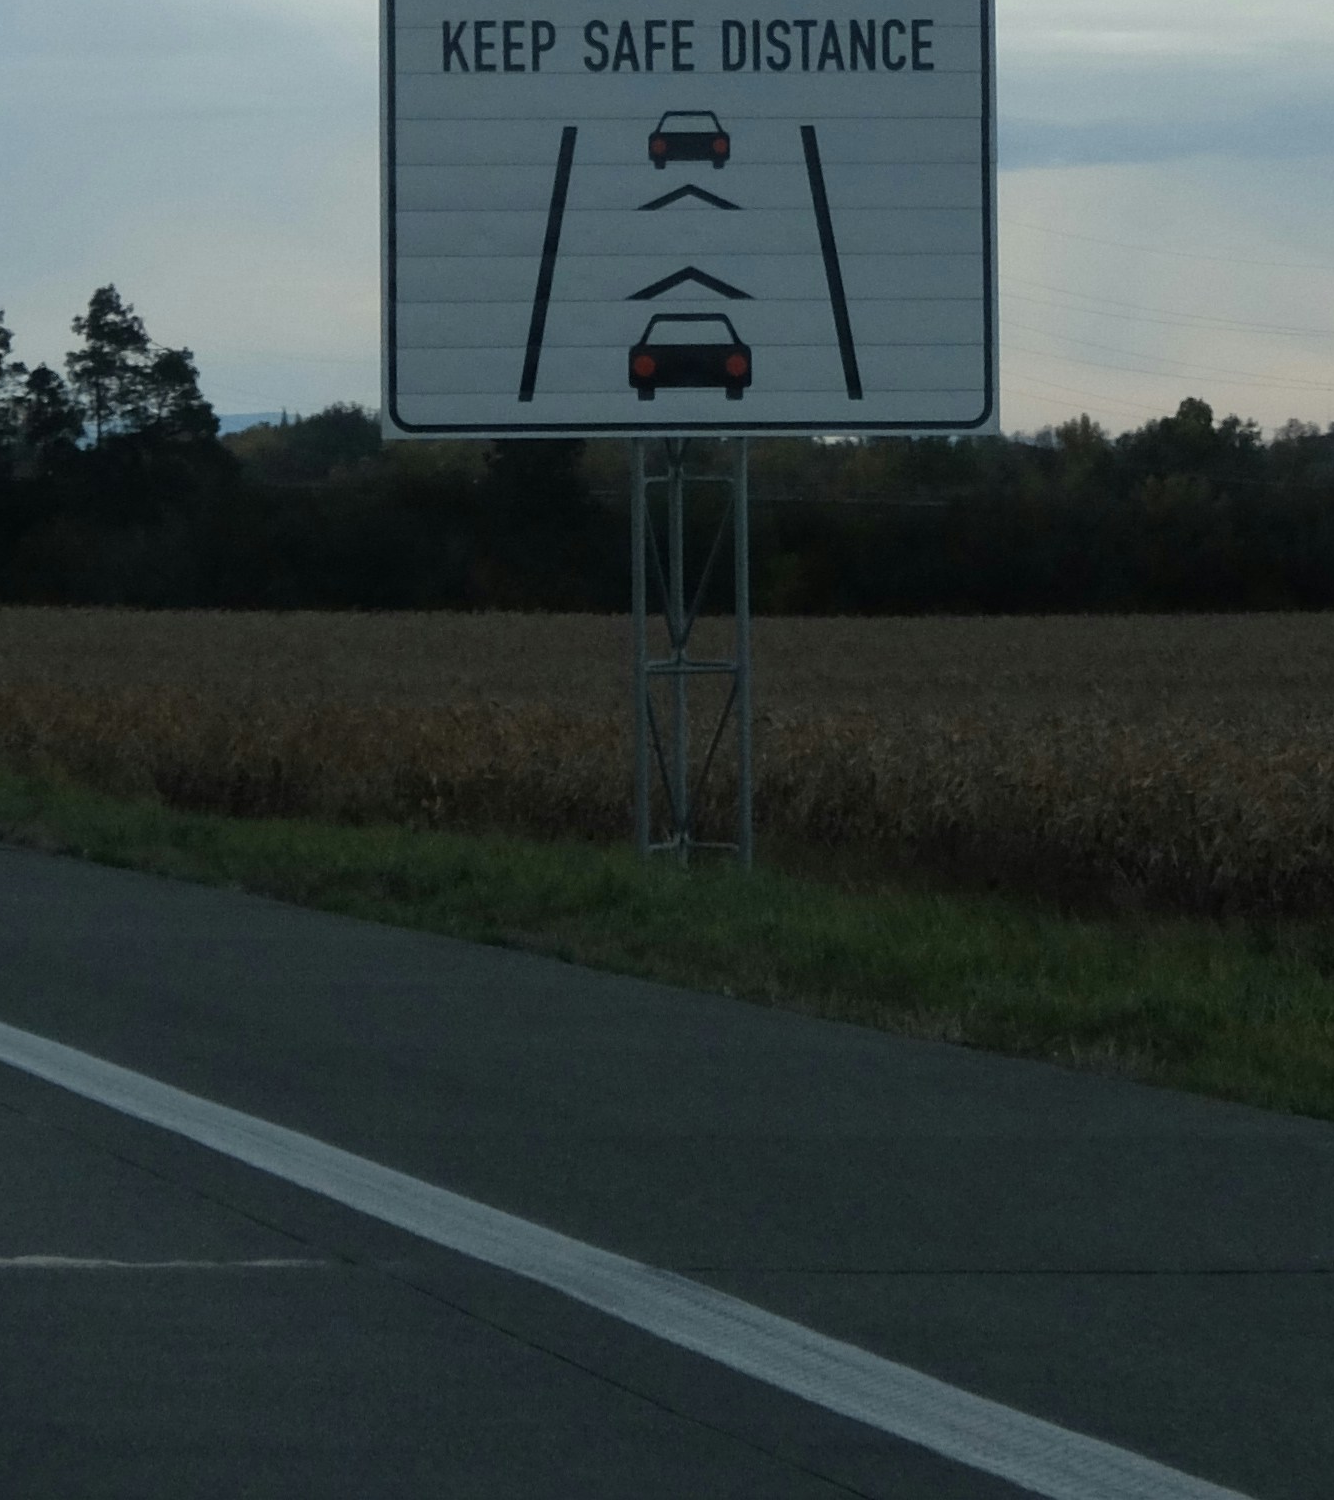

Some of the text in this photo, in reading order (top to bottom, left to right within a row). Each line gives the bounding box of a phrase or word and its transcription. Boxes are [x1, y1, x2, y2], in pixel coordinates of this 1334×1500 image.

[441, 18, 935, 73] KEEP SAFE DISTANCE
